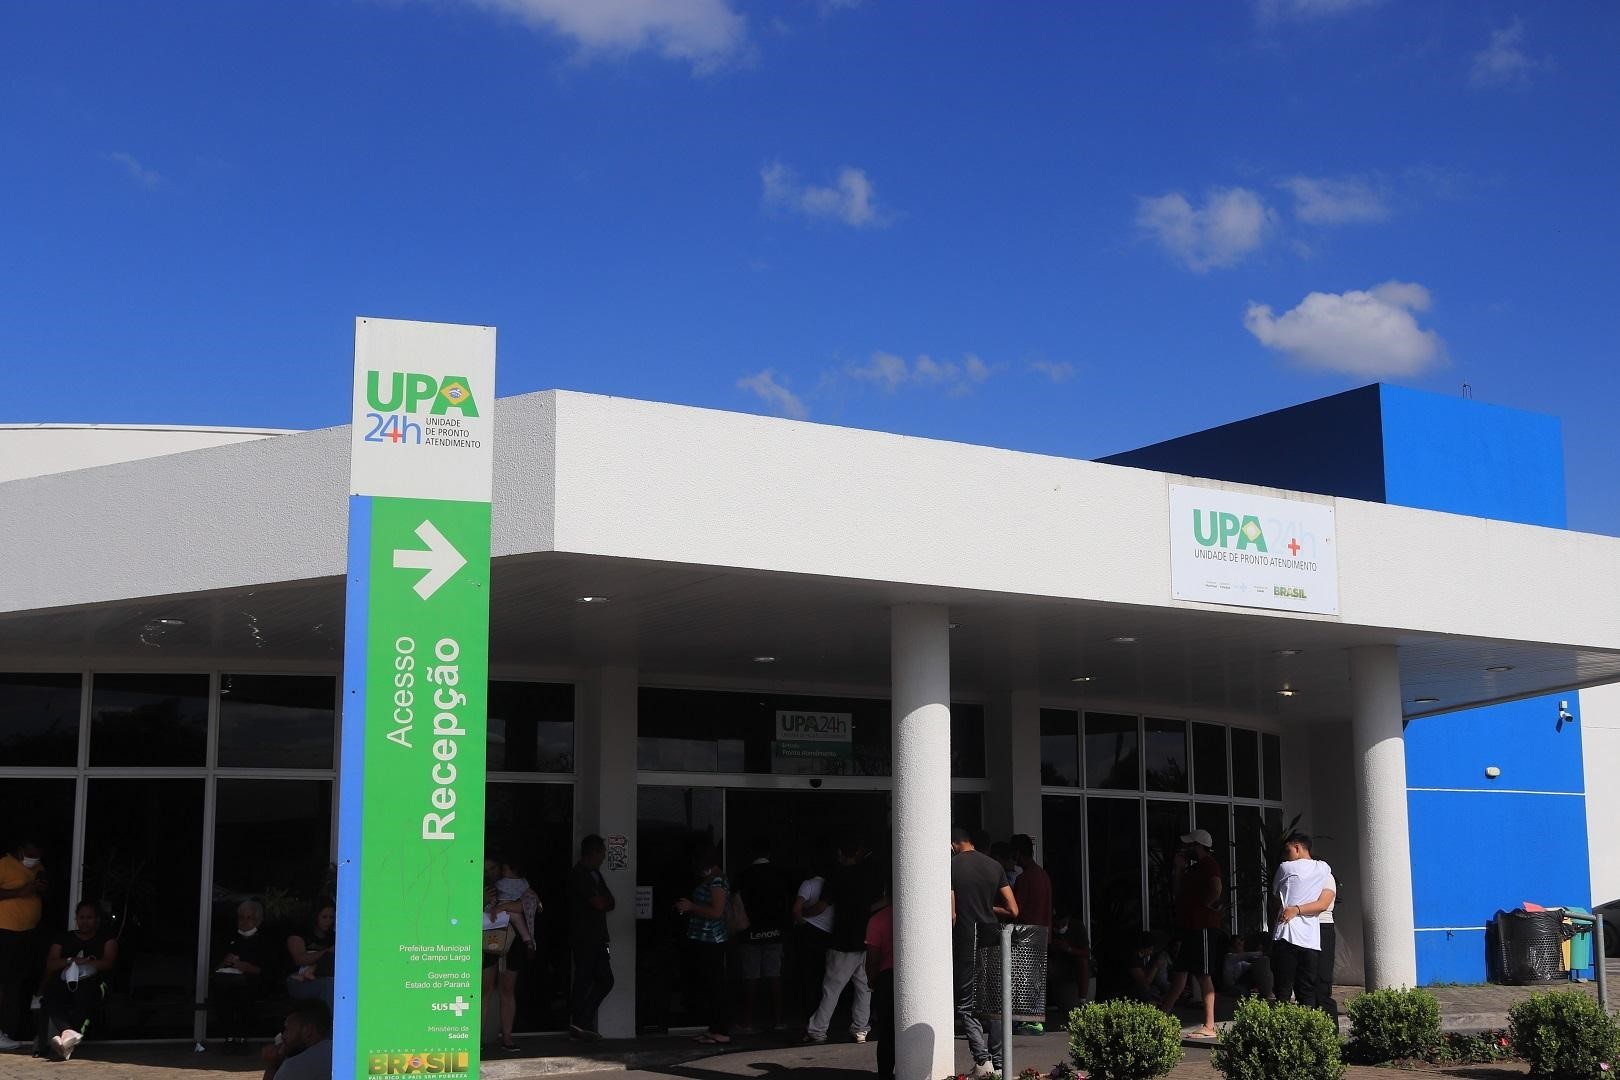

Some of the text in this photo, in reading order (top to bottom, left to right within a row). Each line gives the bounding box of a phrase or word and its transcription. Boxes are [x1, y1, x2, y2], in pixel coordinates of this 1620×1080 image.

[366, 370, 479, 418] UPA
[364, 412, 422, 445] 24h
[425, 417, 461, 428] UNIDADE
[425, 427, 470, 438] DE PRONTO
[425, 437, 481, 449] ATENDIMENTO
[1193, 508, 1268, 553] UPA
[1194, 549, 1318, 572] UNIDADE DE PRONTO ATENDIMENTO
[1273, 585, 1308, 599] BRASIL
[386, 636, 415, 748] Acesso
[782, 714, 847, 734] UPA 24h
[422, 637, 467, 840] Recepção
[399, 944, 471, 953] Prefeitura Municipal
[421, 953, 448, 963] Campo
[449, 953, 471, 962] Largo
[427, 971, 471, 980] Governo do
[405, 980, 470, 989] Estado do Paraná
[431, 1003, 449, 1011] SUS
[368, 1051, 468, 1075] BRASIL
